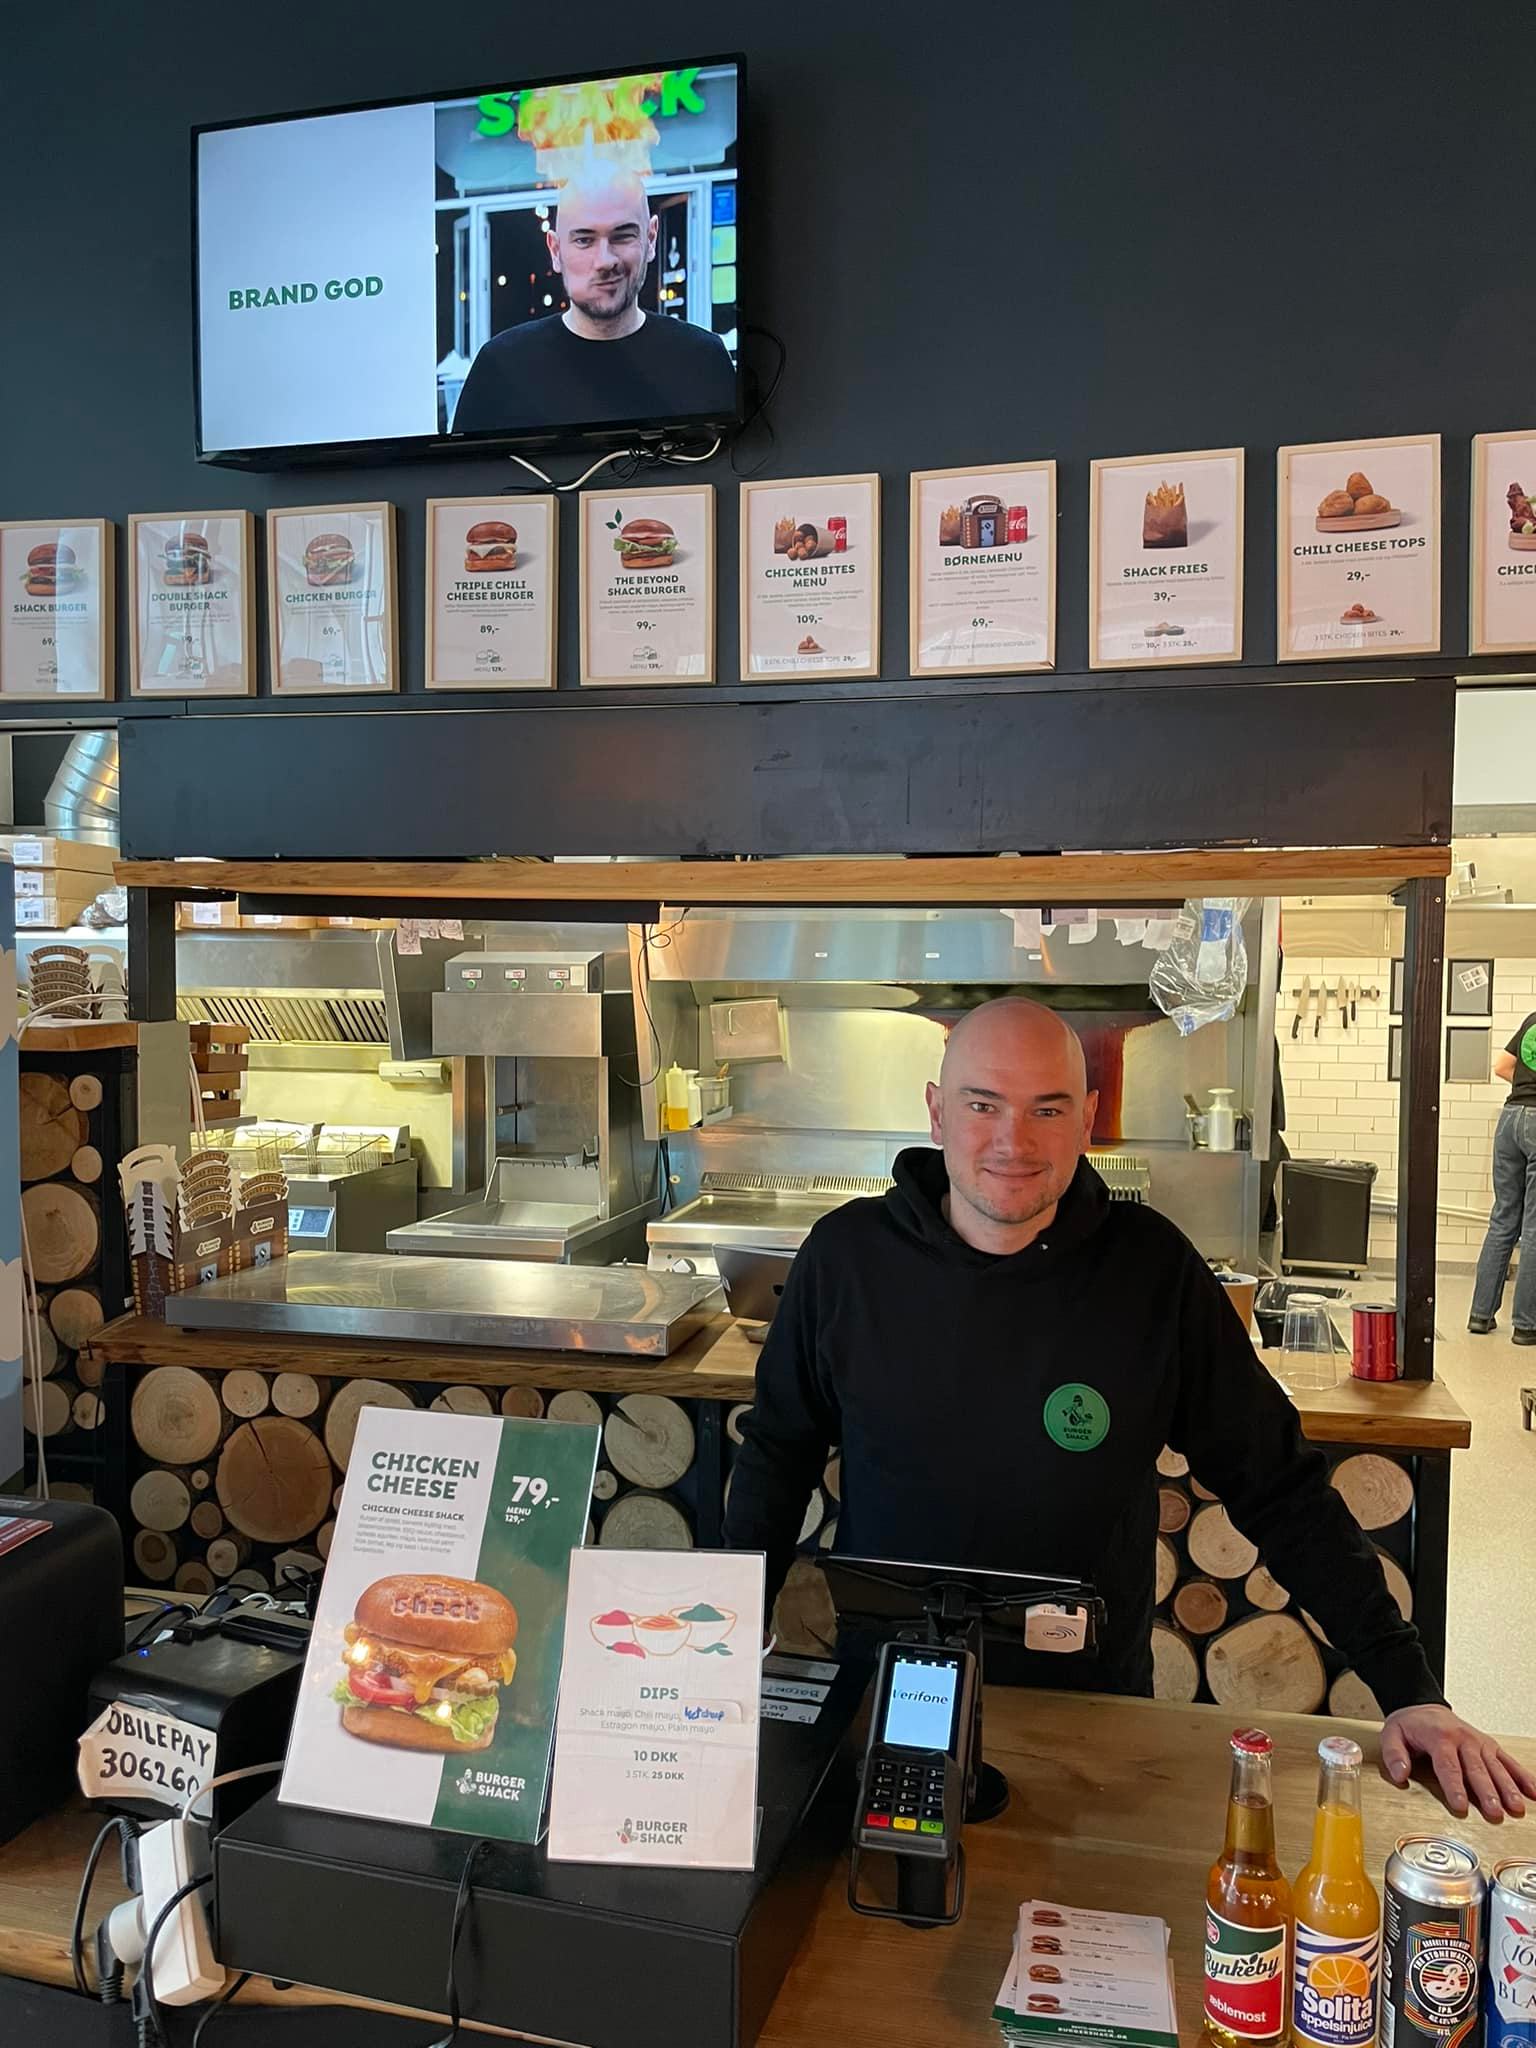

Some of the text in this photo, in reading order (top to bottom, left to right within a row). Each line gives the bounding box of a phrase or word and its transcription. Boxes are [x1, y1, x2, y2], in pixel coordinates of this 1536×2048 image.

[228, 275, 384, 310] BRAND GOD
[1293, 537, 1426, 556] CHILI CHEESE TOPS
[944, 552, 1023, 567] BØRNEMENU
[765, 564, 856, 578] CHICKEN BITES
[1123, 563, 1209, 581] SHACK FRIES
[1497, 562, 1536, 576] CHIC
[615, 575, 679, 585] THE BEYOND
[792, 577, 828, 588] MENU
[1346, 571, 1371, 582] 29,-
[455, 580, 527, 591] TRIPLE CHILI
[607, 584, 687, 597] SHACK BURGER
[151, 590, 228, 602] DOUBLE SHACK
[285, 589, 377, 603] CHICKEN BURGER
[446, 589, 535, 601] CHEESE BURGER
[1153, 591, 1177, 603] 39,-
[13, 602, 88, 613] SHACK BURGER
[169, 602, 211, 612] BURGER
[636, 620, 657, 630] 99,-
[796, 614, 823, 625] 109,-
[971, 617, 994, 629] 69,-
[322, 626, 342, 636] 69,-
[479, 624, 501, 635] 89,-
[371, 1451, 480, 1479] CHICKEN
[367, 1473, 459, 1500] CHEESE
[510, 1475, 560, 1510] 79,-
[361, 1503, 465, 1522] CHICKEN CHEESE SHACK
[505, 1505, 533, 1516] MENU
[504, 1514, 526, 1526] 129,-
[639, 1686, 680, 1700] DIPS
[892, 1688, 949, 1705] Verifone
[579, 1707, 604, 1717] Shack
[606, 1709, 633, 1719] mayo,
[634, 1709, 654, 1719] Chili
[600, 1720, 639, 1732] Estragon
[667, 1723, 689, 1733] Plain
[689, 1724, 716, 1735] mayo
[105, 1709, 212, 1768] OBILEPAY
[633, 1750, 679, 1763] 10 DKK
[475, 1771, 527, 1790] BURGER
[625, 1769, 630, 1778] 3
[651, 1771, 664, 1780] 25
[664, 1771, 685, 1781] DKK
[477, 1784, 521, 1801] SHACK
[635, 1820, 689, 1833] BURGER
[639, 1833, 684, 1845] SHACK
[1423, 1949, 1468, 1964] STONEWALL
[1205, 1951, 1279, 1979] Rynkeby
[1208, 1994, 1267, 2024] æblemost
[1302, 1986, 1373, 2022] Solita
[1438, 2006, 1453, 2014] IPA
[1300, 2009, 1374, 2035] appelsinjuice
